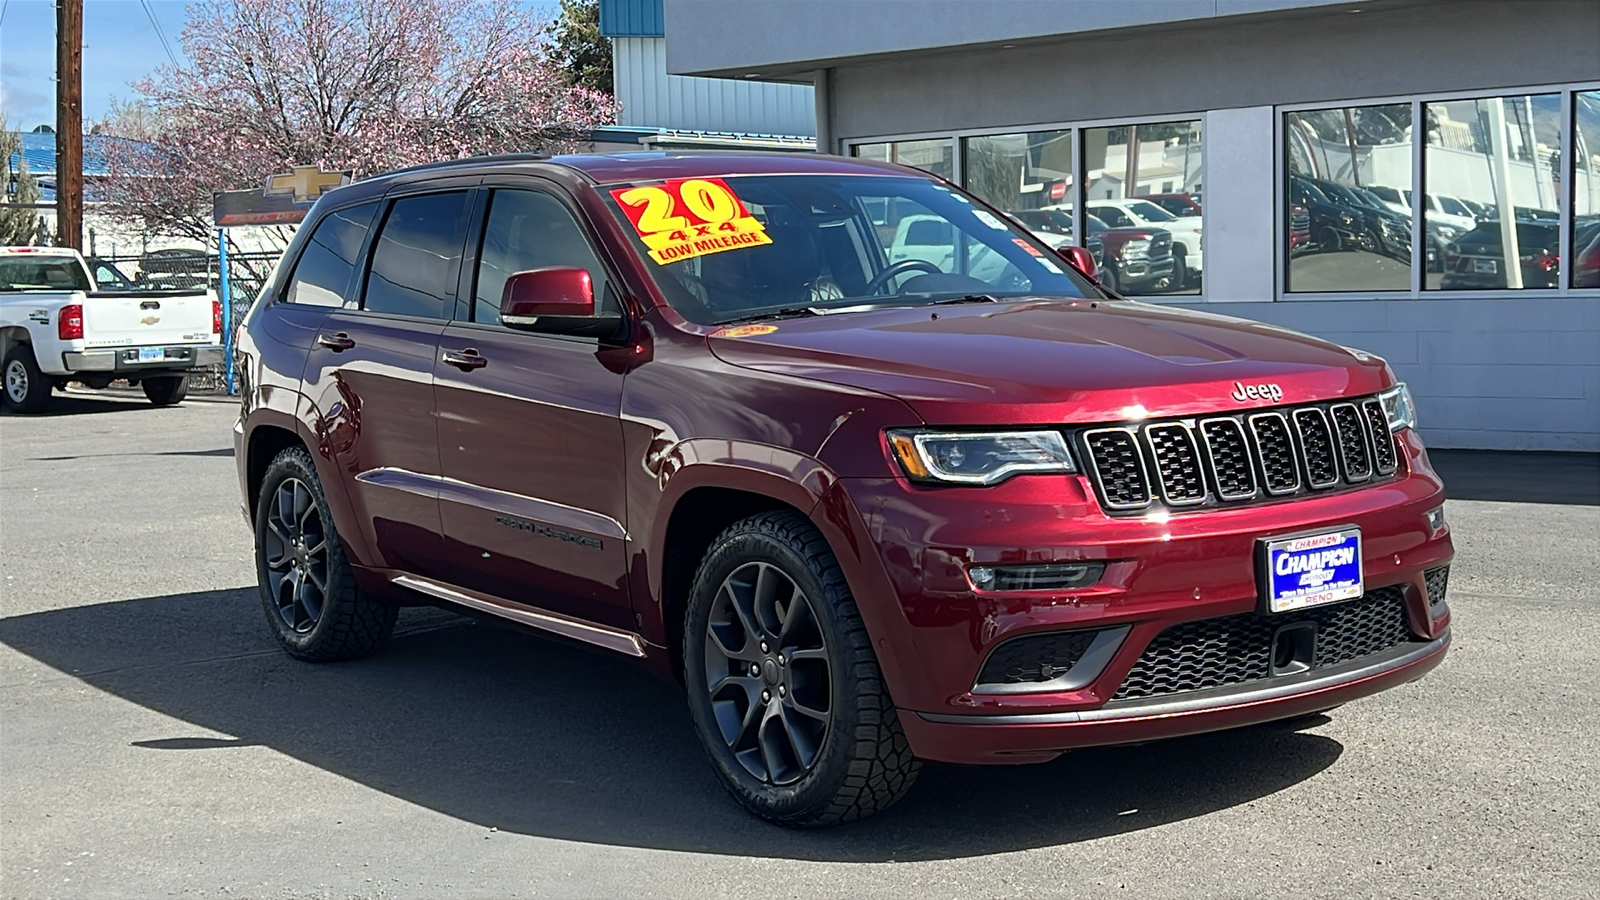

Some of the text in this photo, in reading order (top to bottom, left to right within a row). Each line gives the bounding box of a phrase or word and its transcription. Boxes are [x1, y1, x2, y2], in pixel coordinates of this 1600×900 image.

[619, 179, 741, 233] 20
[657, 232, 763, 261] LOW MILEAGE
[1231, 381, 1283, 403] Jeep
[1294, 535, 1338, 550] CHAMPION
[1275, 546, 1355, 576] CHAMPION
[1305, 592, 1333, 604] RENO
